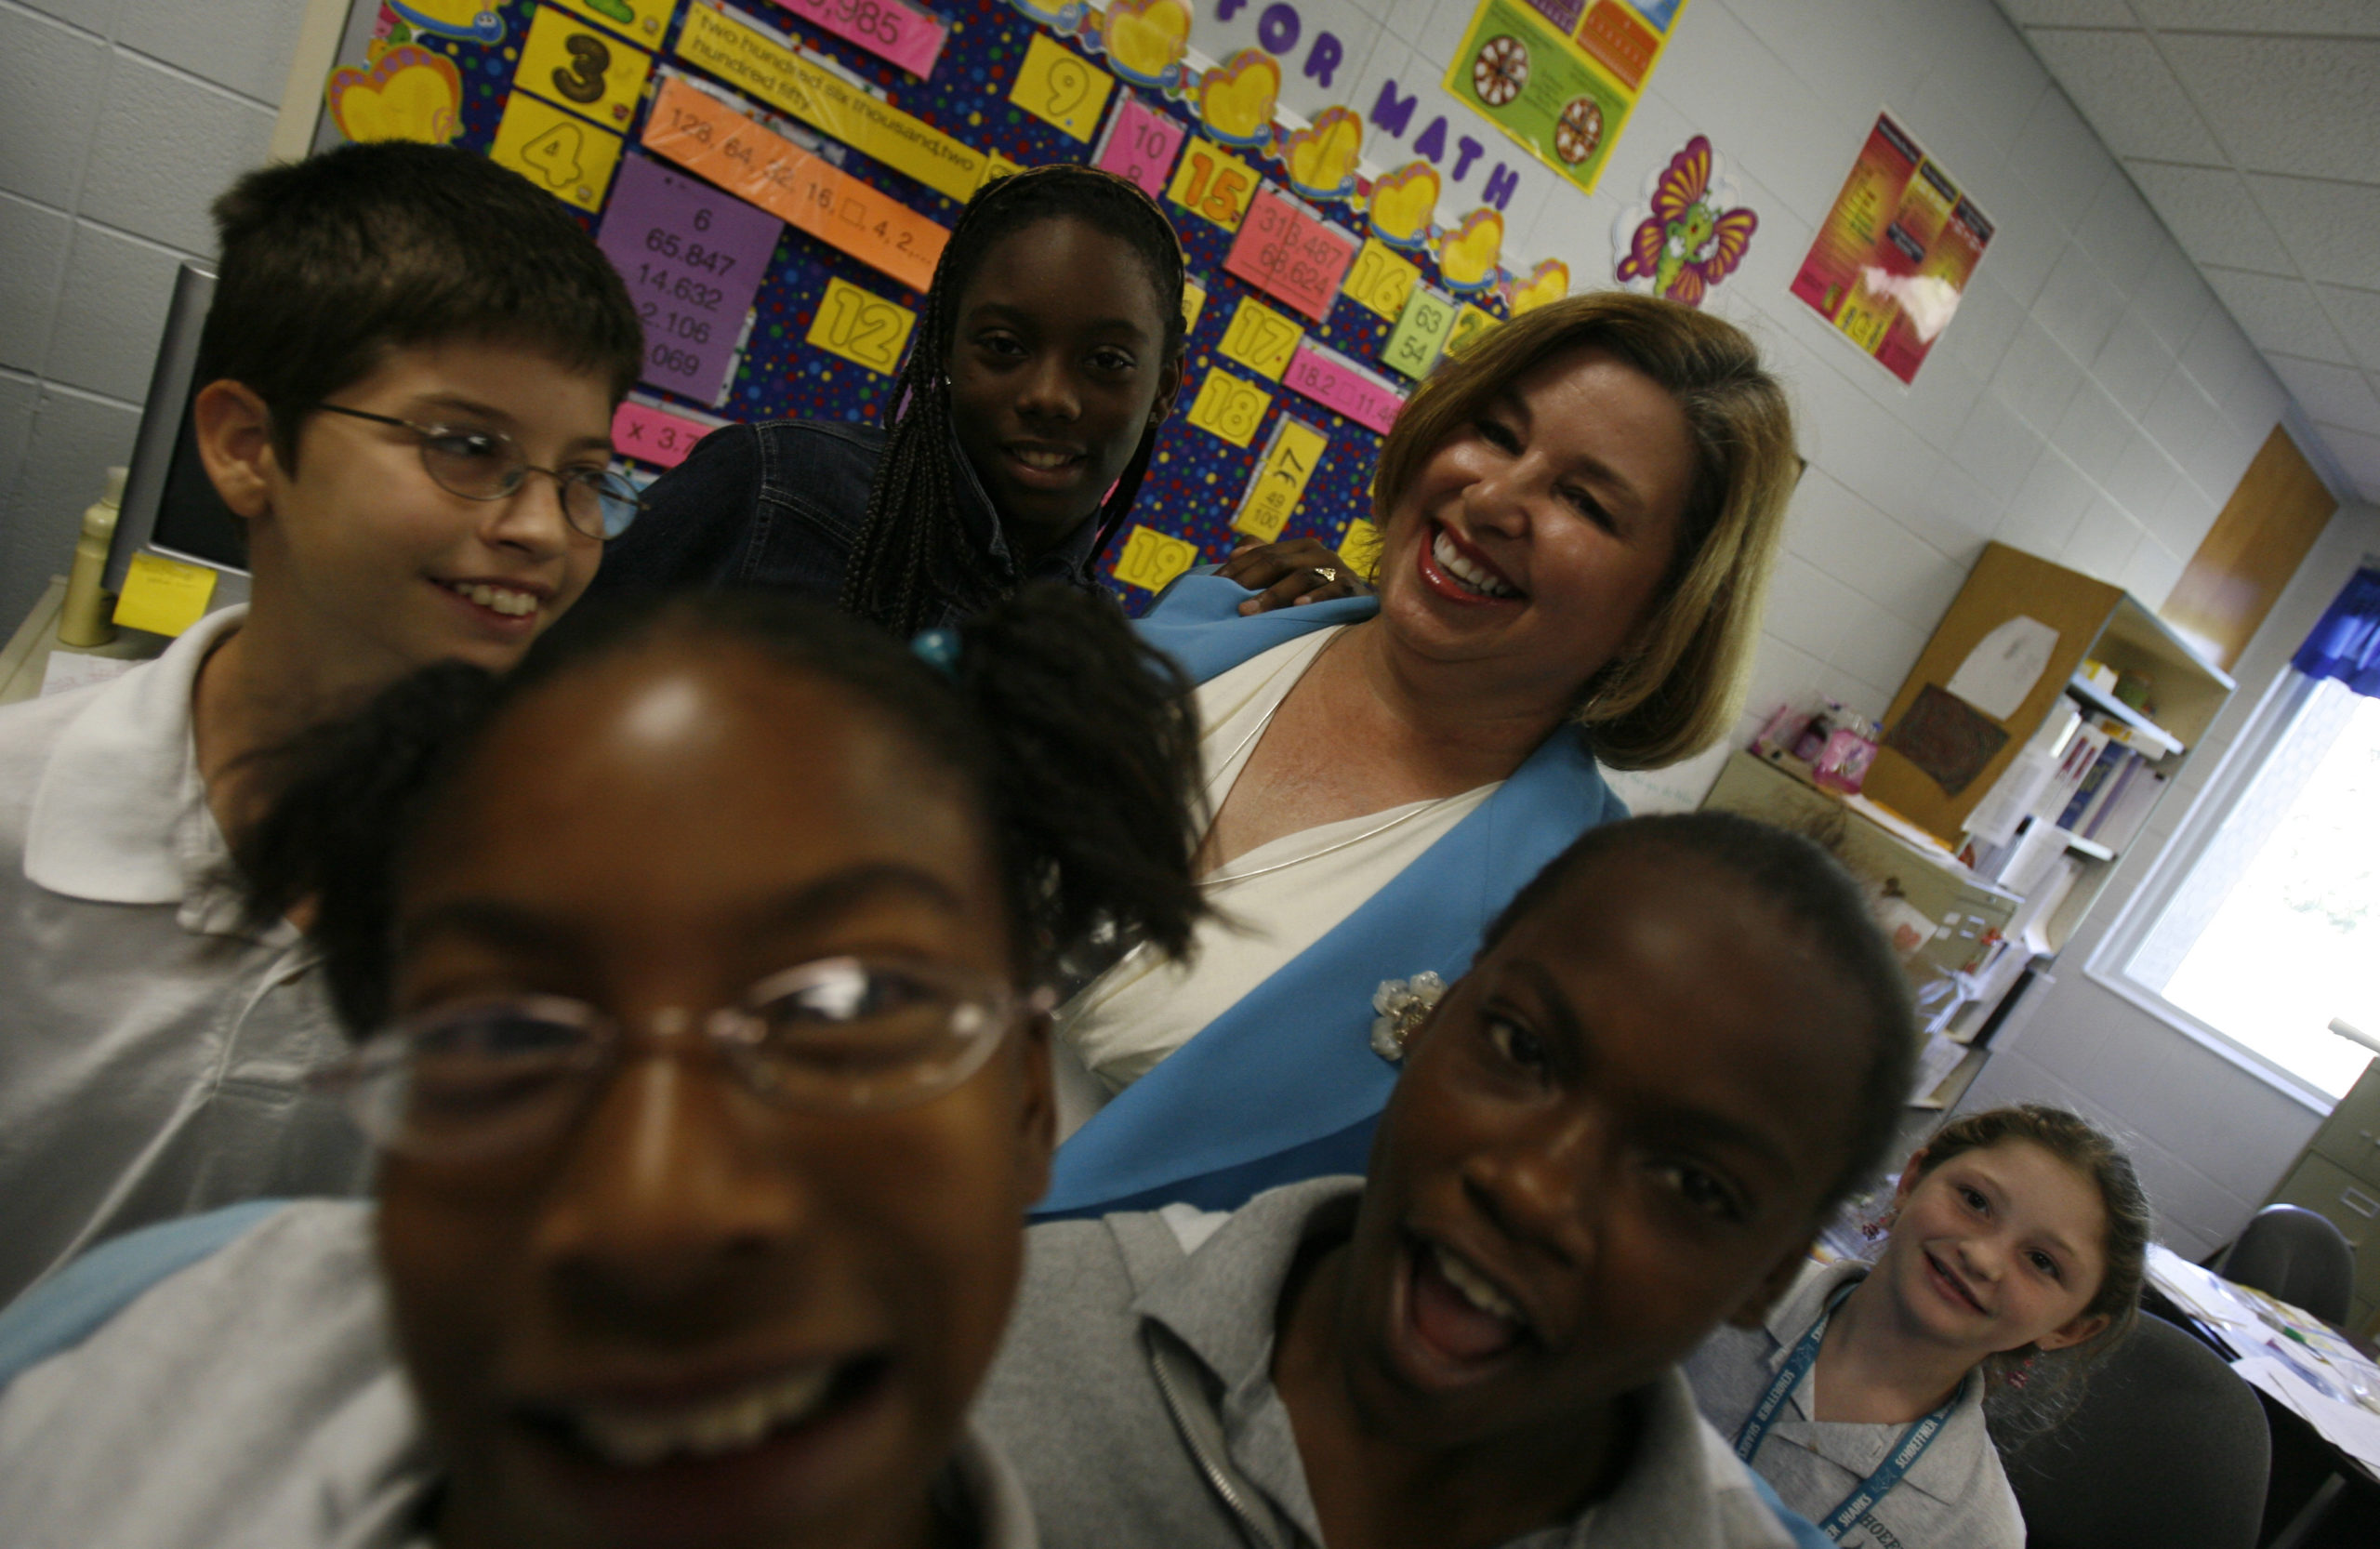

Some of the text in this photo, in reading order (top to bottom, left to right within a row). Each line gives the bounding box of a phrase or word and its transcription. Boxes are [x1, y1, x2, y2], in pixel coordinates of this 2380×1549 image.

[552, 33, 610, 103] 3
[692, 37, 777, 91] hundred
[701, 16, 738, 43] two
[739, 31, 822, 88] hundred
[521, 122, 582, 186] 4
[1135, 124, 1167, 159] 10
[1370, 80, 1519, 211] MATH
[1183, 152, 1248, 221] 15
[694, 209, 712, 232] 6
[646, 228, 735, 277] 65.847
[1355, 250, 1407, 314] 16
[639, 264, 722, 311] 14.632
[639, 301, 710, 345] 2.106
[829, 287, 903, 364] 12
[1235, 306, 1295, 365] 17
[1415, 305, 1442, 334] 63
[1399, 336, 1428, 364] 54
[1204, 376, 1260, 438] 18
[1130, 532, 1187, 585] 19
[1837, 1492, 1873, 1528] SHARKS
[1895, 1419, 1939, 1470] SCHOEFFNER
